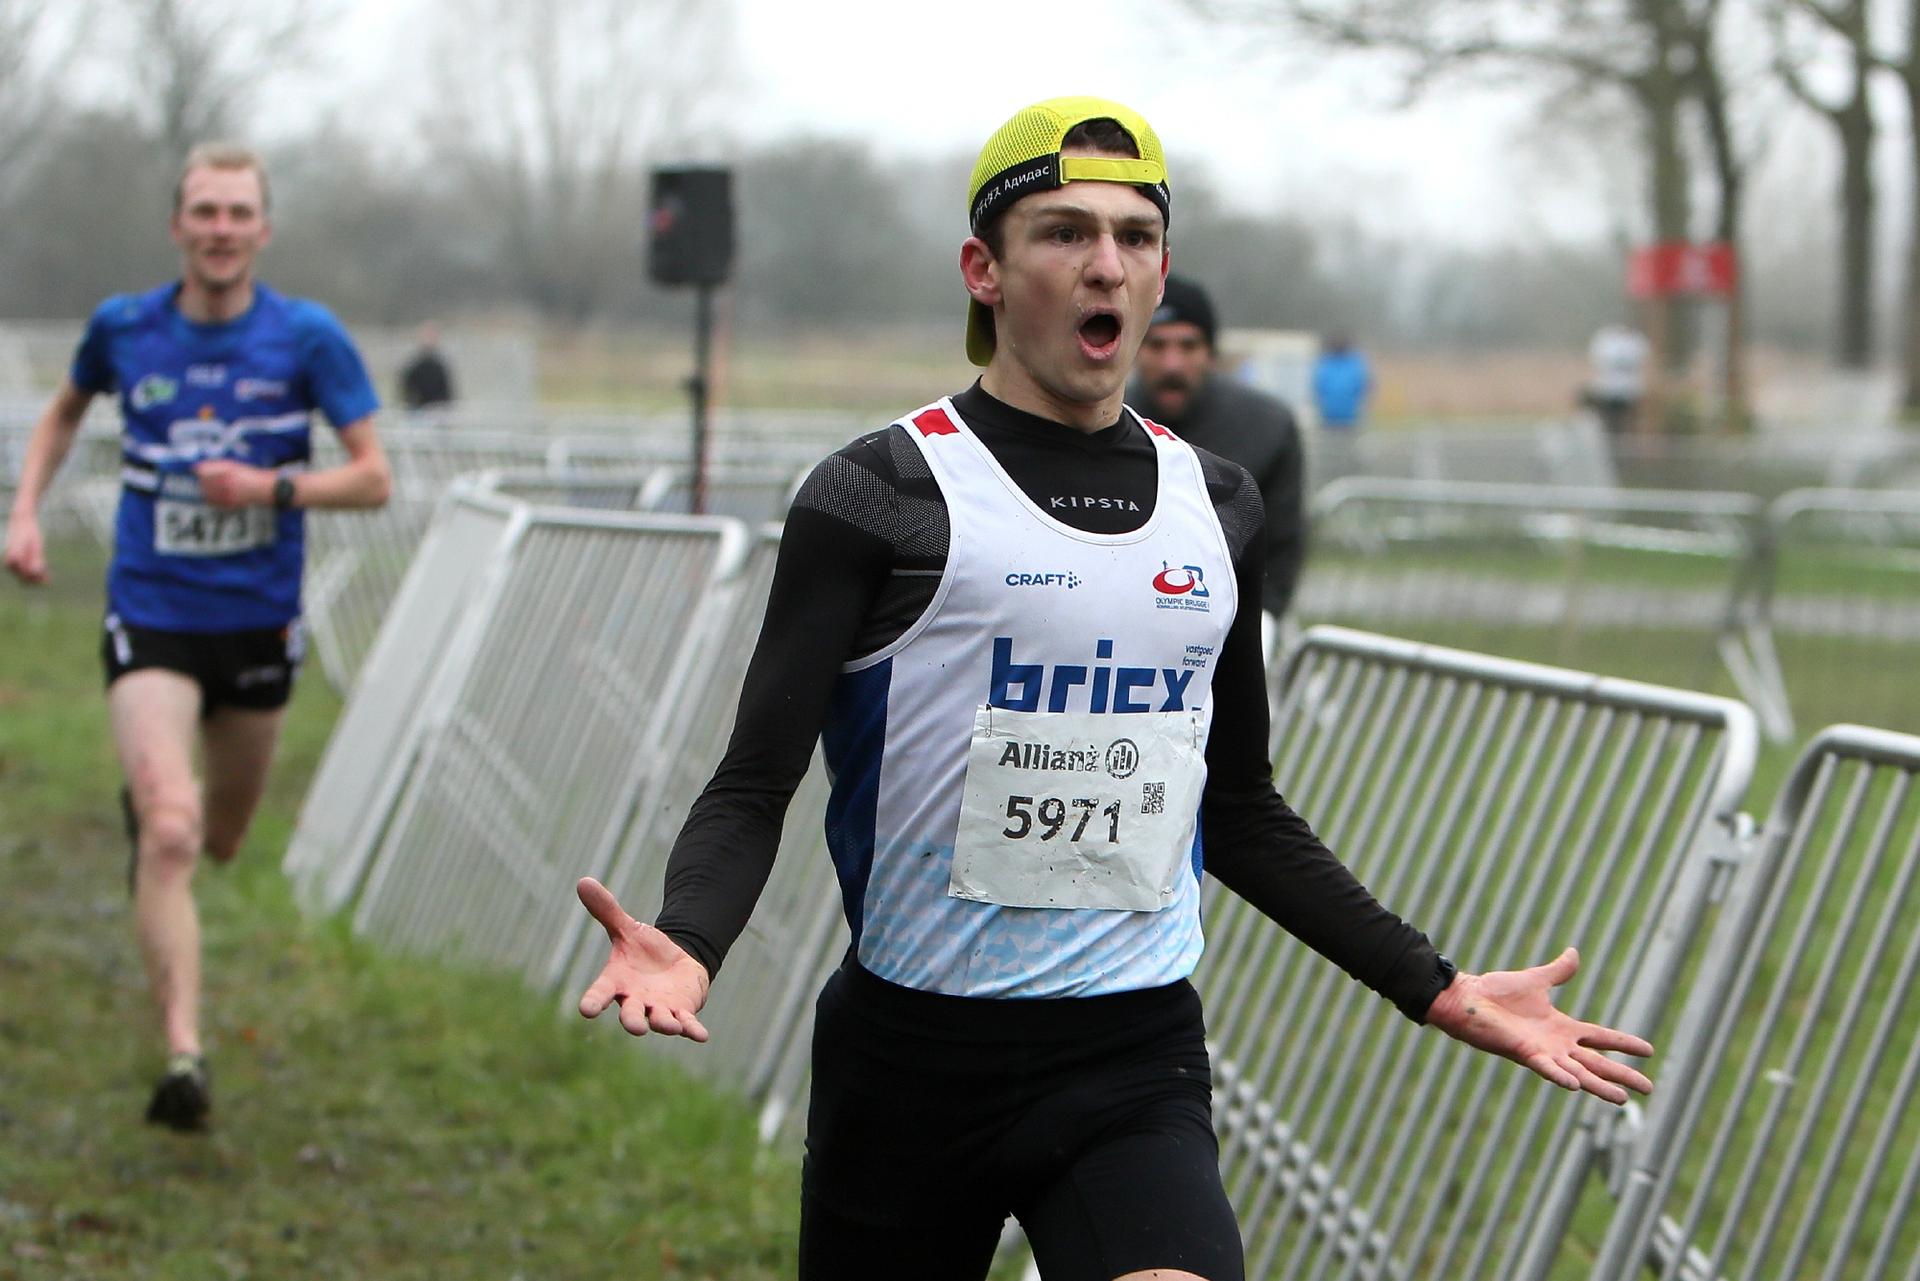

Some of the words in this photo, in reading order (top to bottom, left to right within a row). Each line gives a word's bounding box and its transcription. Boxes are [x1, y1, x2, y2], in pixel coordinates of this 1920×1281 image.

[1004, 165, 1050, 191] Адидас
[1050, 496, 1140, 512] KIPSTA
[1005, 572, 1067, 587] CRAFT
[1155, 597, 1183, 605] OLYMPIC
[1185, 645, 1214, 656] vastgoed
[1182, 656, 1207, 668] forward
[1002, 795, 1122, 844] 5971
